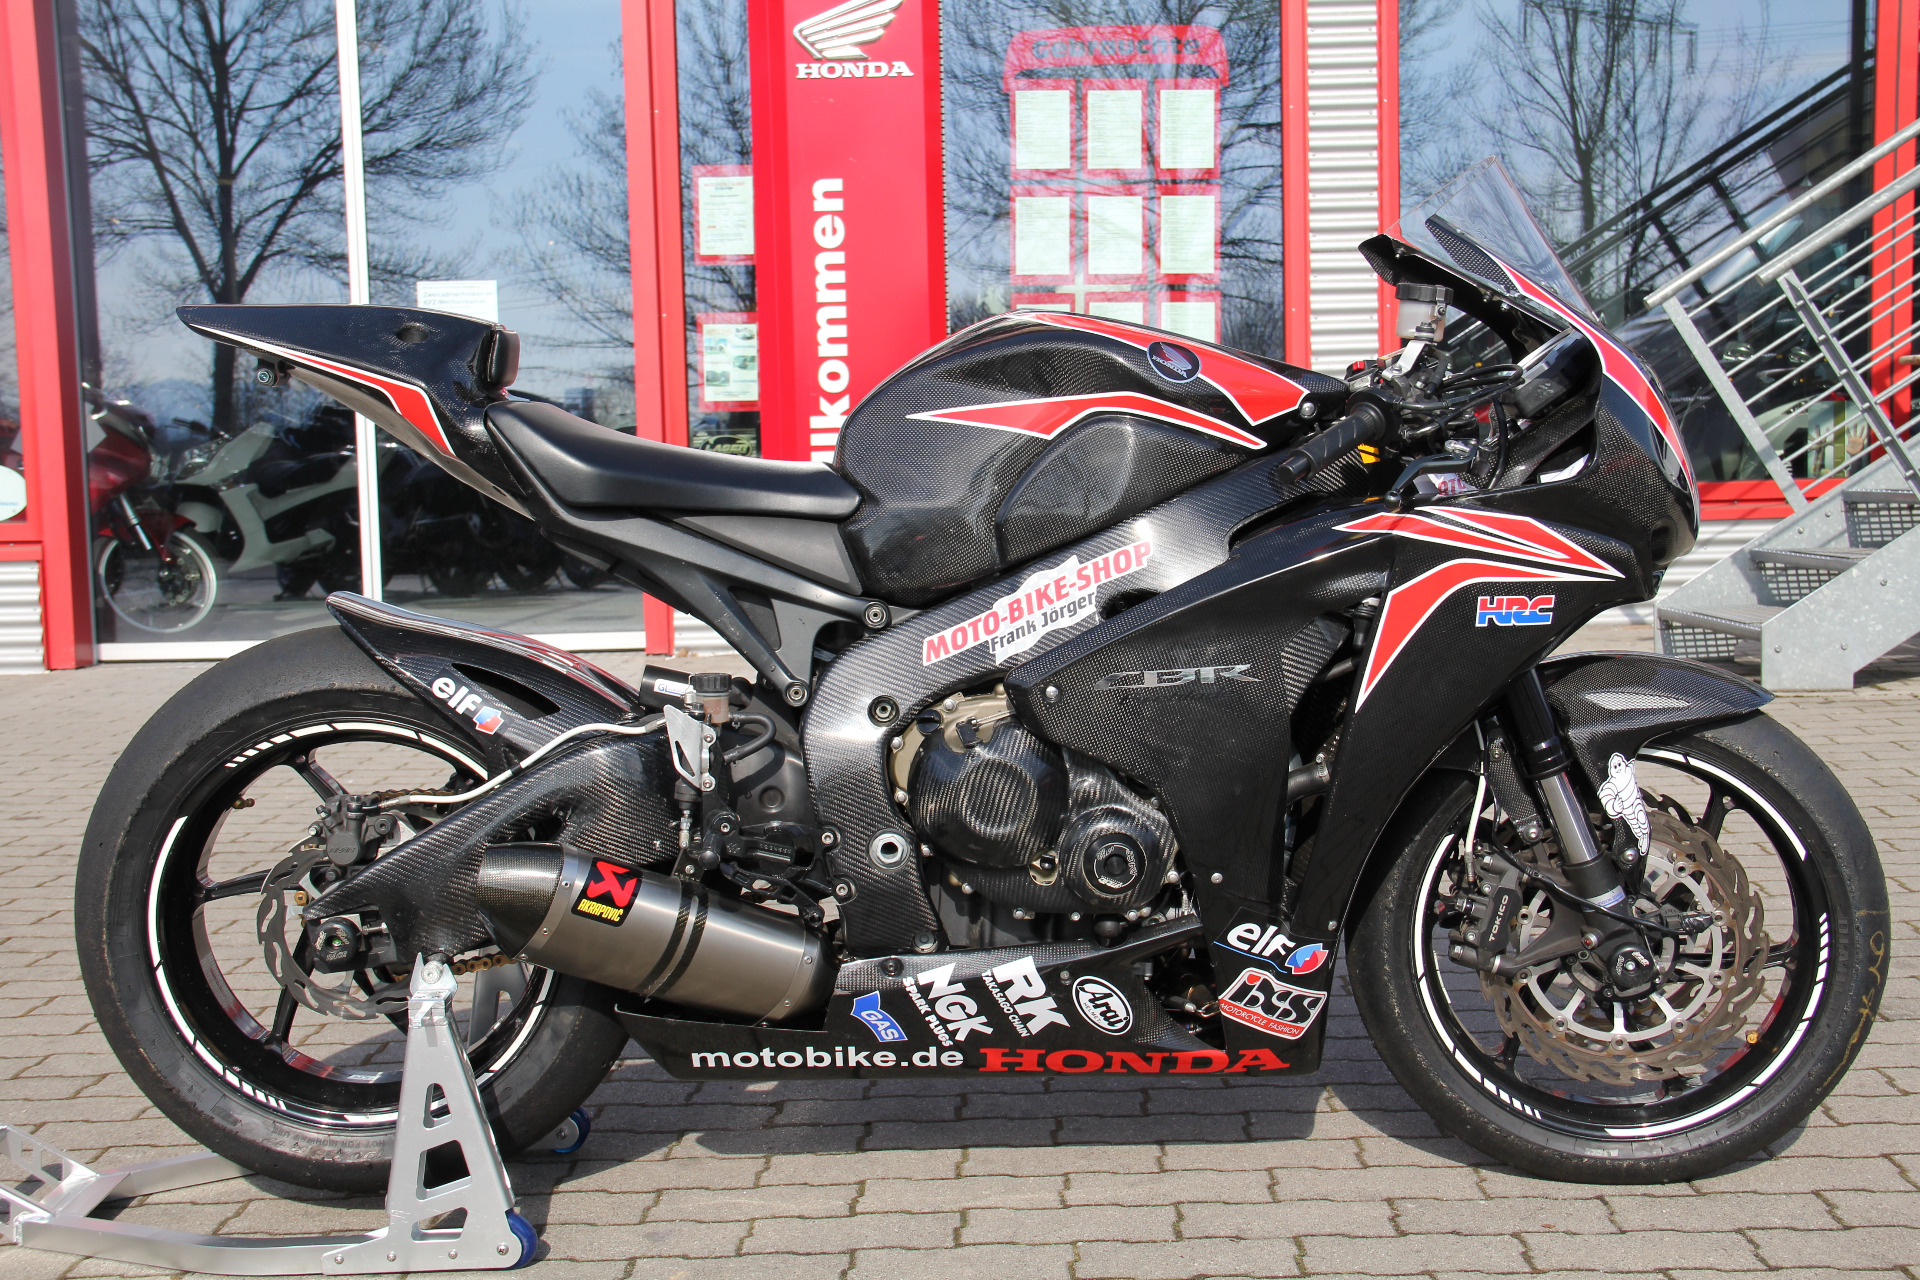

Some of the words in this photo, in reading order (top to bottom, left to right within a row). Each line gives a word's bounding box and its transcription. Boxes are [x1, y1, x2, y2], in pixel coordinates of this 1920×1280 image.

[1031, 36, 1200, 59] Gebrauchte
[795, 61, 915, 79] HONDA
[1152, 355, 1188, 378] HONDA
[925, 541, 1151, 663] MOTO-BIKE-SHOP
[1475, 595, 1555, 627] HRC
[990, 619, 1037, 651] Frank
[1041, 592, 1096, 628] Jörger
[431, 677, 483, 715] elf
[1488, 894, 1509, 942] TOKICO
[1227, 922, 1297, 957] elf
[902, 976, 932, 1015] SPARK
[925, 1014, 954, 1047] PLUGS
[916, 962, 994, 1042] NGK
[981, 969, 1014, 1014] TAKASAGO
[1008, 1013, 1031, 1038] CHAIN
[992, 955, 1071, 1036] RK
[1077, 985, 1130, 1027] Arai
[860, 1009, 900, 1041] GAS
[1219, 1002, 1268, 1026] MOTORCYCLE
[1268, 1022, 1300, 1035] FASHION
[691, 1046, 965, 1068] motobike.de
[978, 1048, 1290, 1074] HONDA
